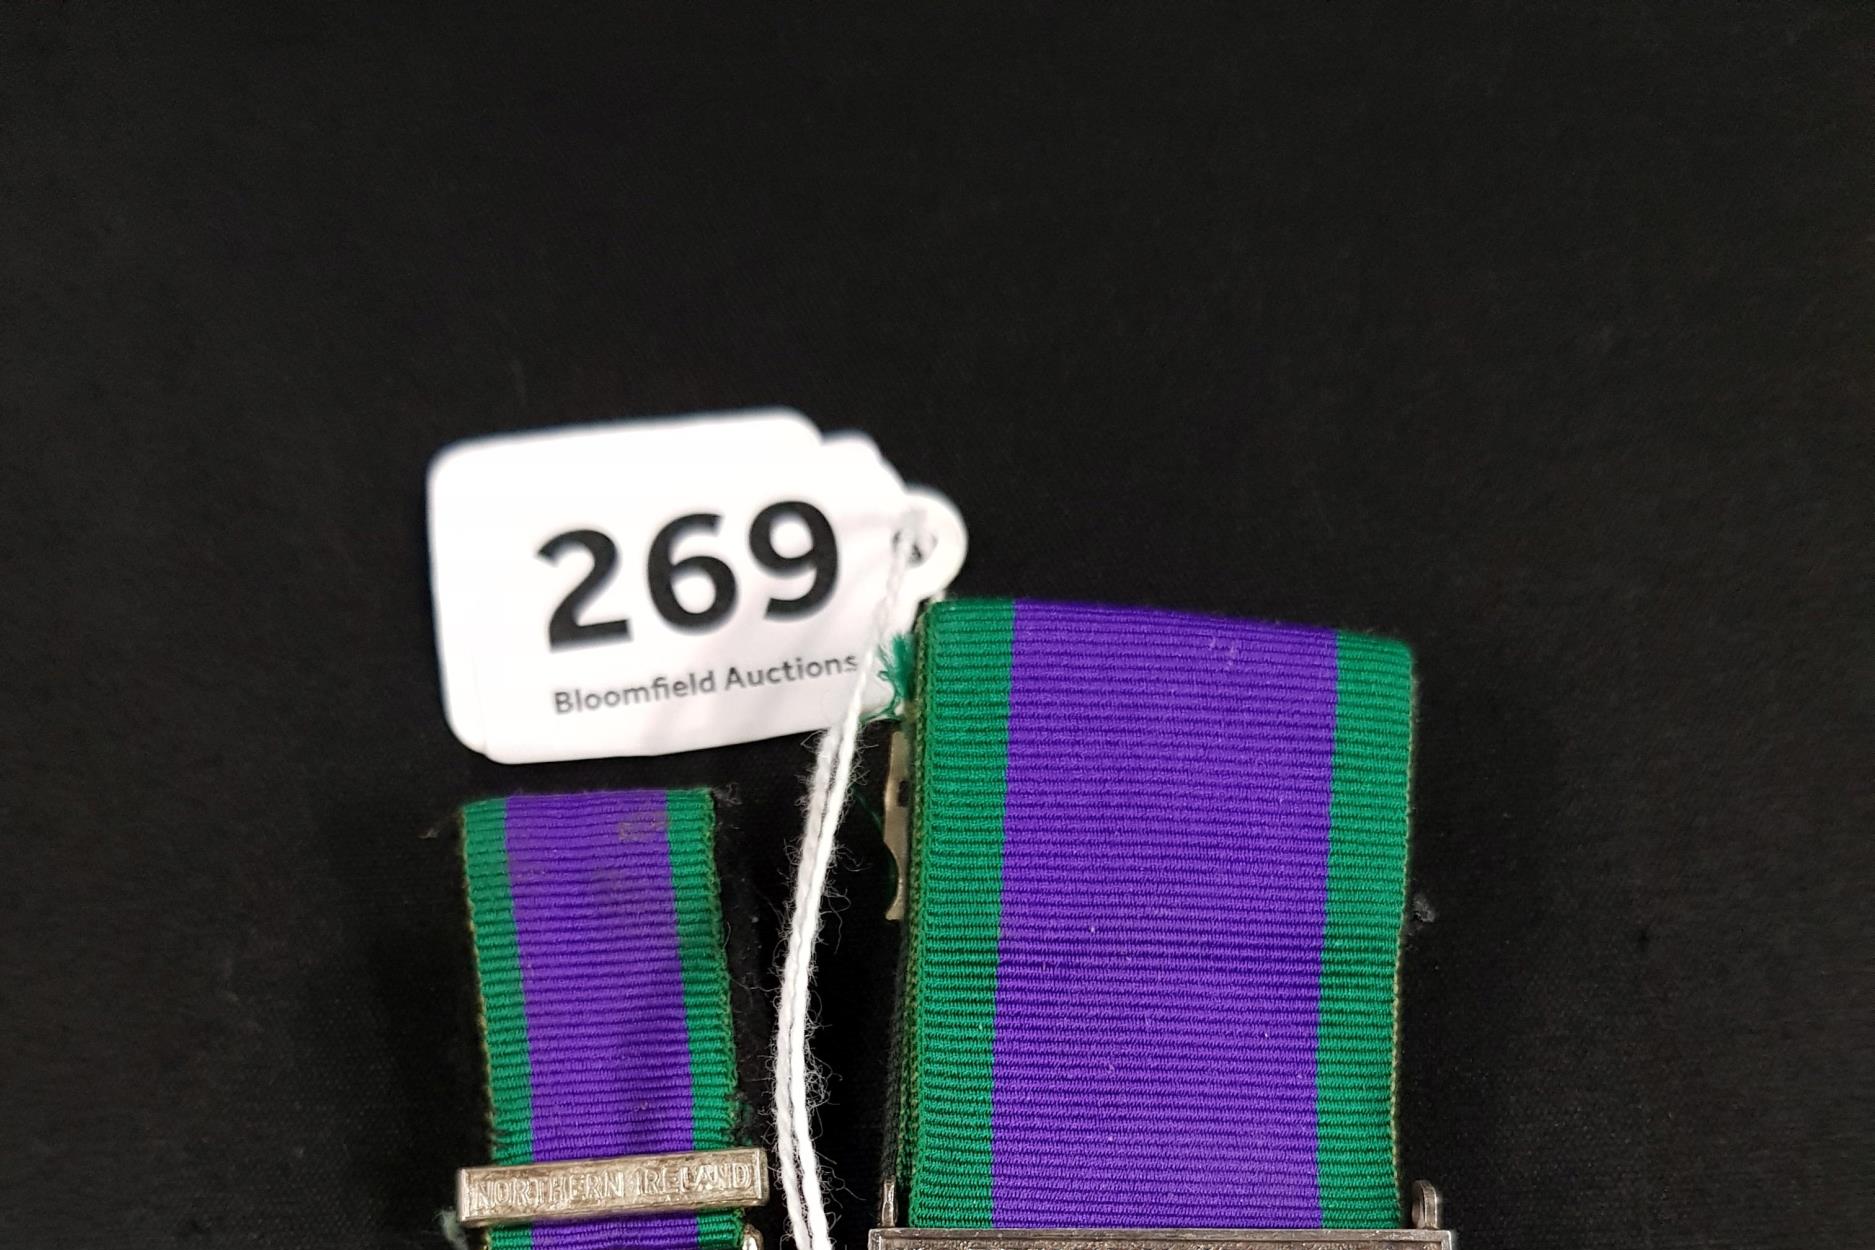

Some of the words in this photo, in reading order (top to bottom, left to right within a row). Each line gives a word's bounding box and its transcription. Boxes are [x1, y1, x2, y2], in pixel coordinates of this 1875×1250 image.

[535, 499, 840, 652] 269
[555, 669, 718, 715] Bloomfield
[724, 654, 858, 690] Auctions
[474, 1171, 624, 1209] NORTHERN
[636, 1161, 752, 1196] IRELAND
